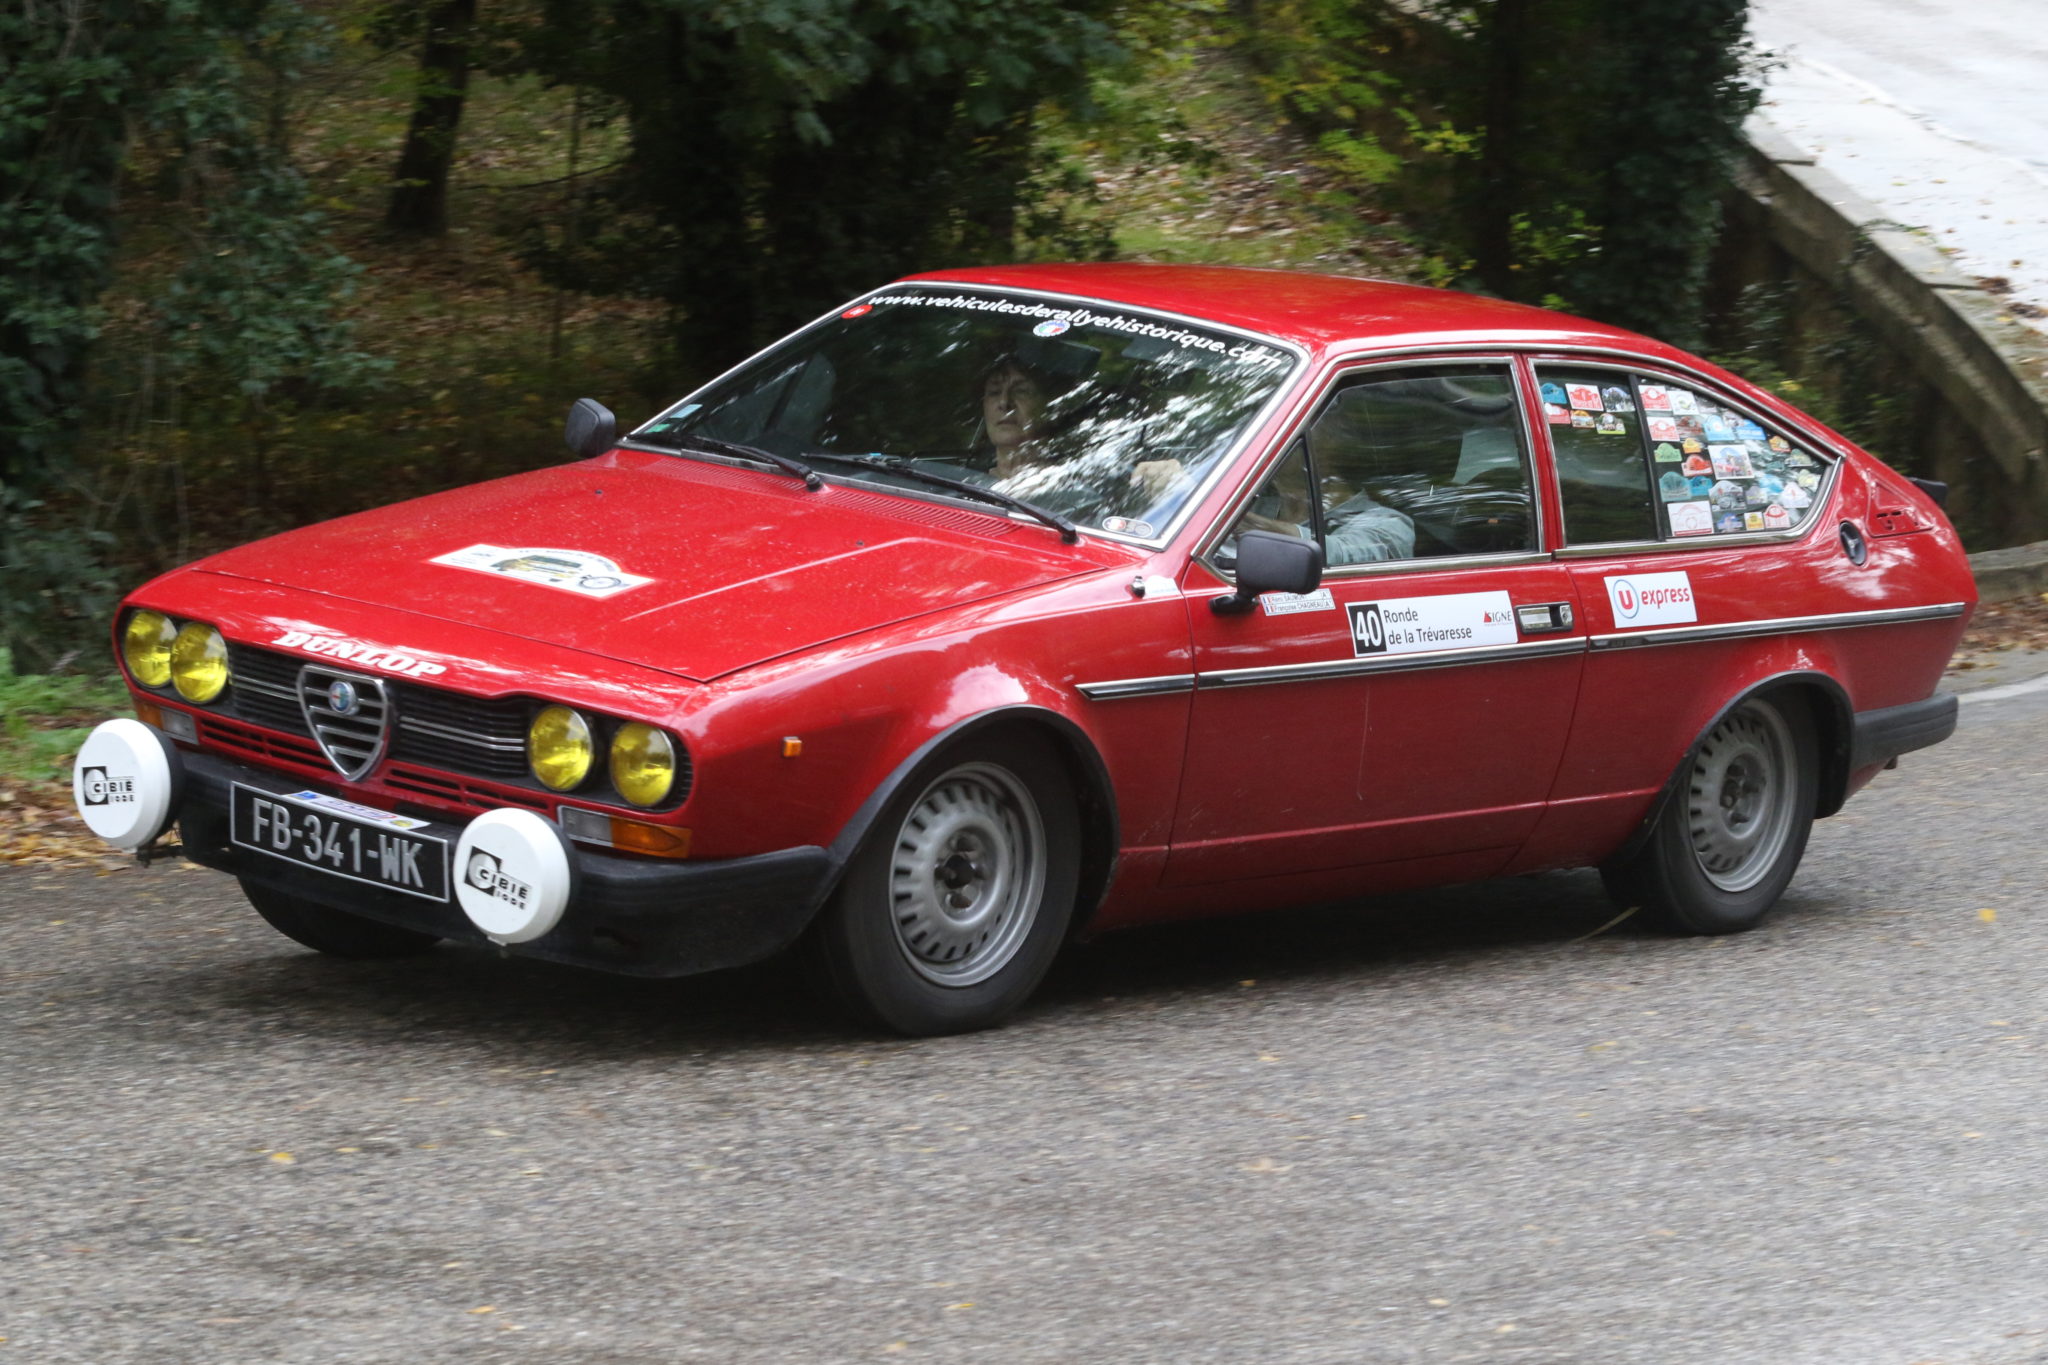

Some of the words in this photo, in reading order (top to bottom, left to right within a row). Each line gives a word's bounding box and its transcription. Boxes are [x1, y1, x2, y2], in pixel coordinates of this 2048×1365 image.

[868, 295, 1281, 369] www.vehiculesderallyehistorique.com
[1384, 607, 1419, 623] Ronde
[1641, 587, 1690, 609] express
[1356, 609, 1382, 648] 40
[1389, 631, 1402, 645] de
[1404, 629, 1415, 643] la
[1416, 626, 1472, 643] Trévaresse
[271, 631, 448, 677] DUNLOP
[253, 797, 424, 889] FB-341-WK
